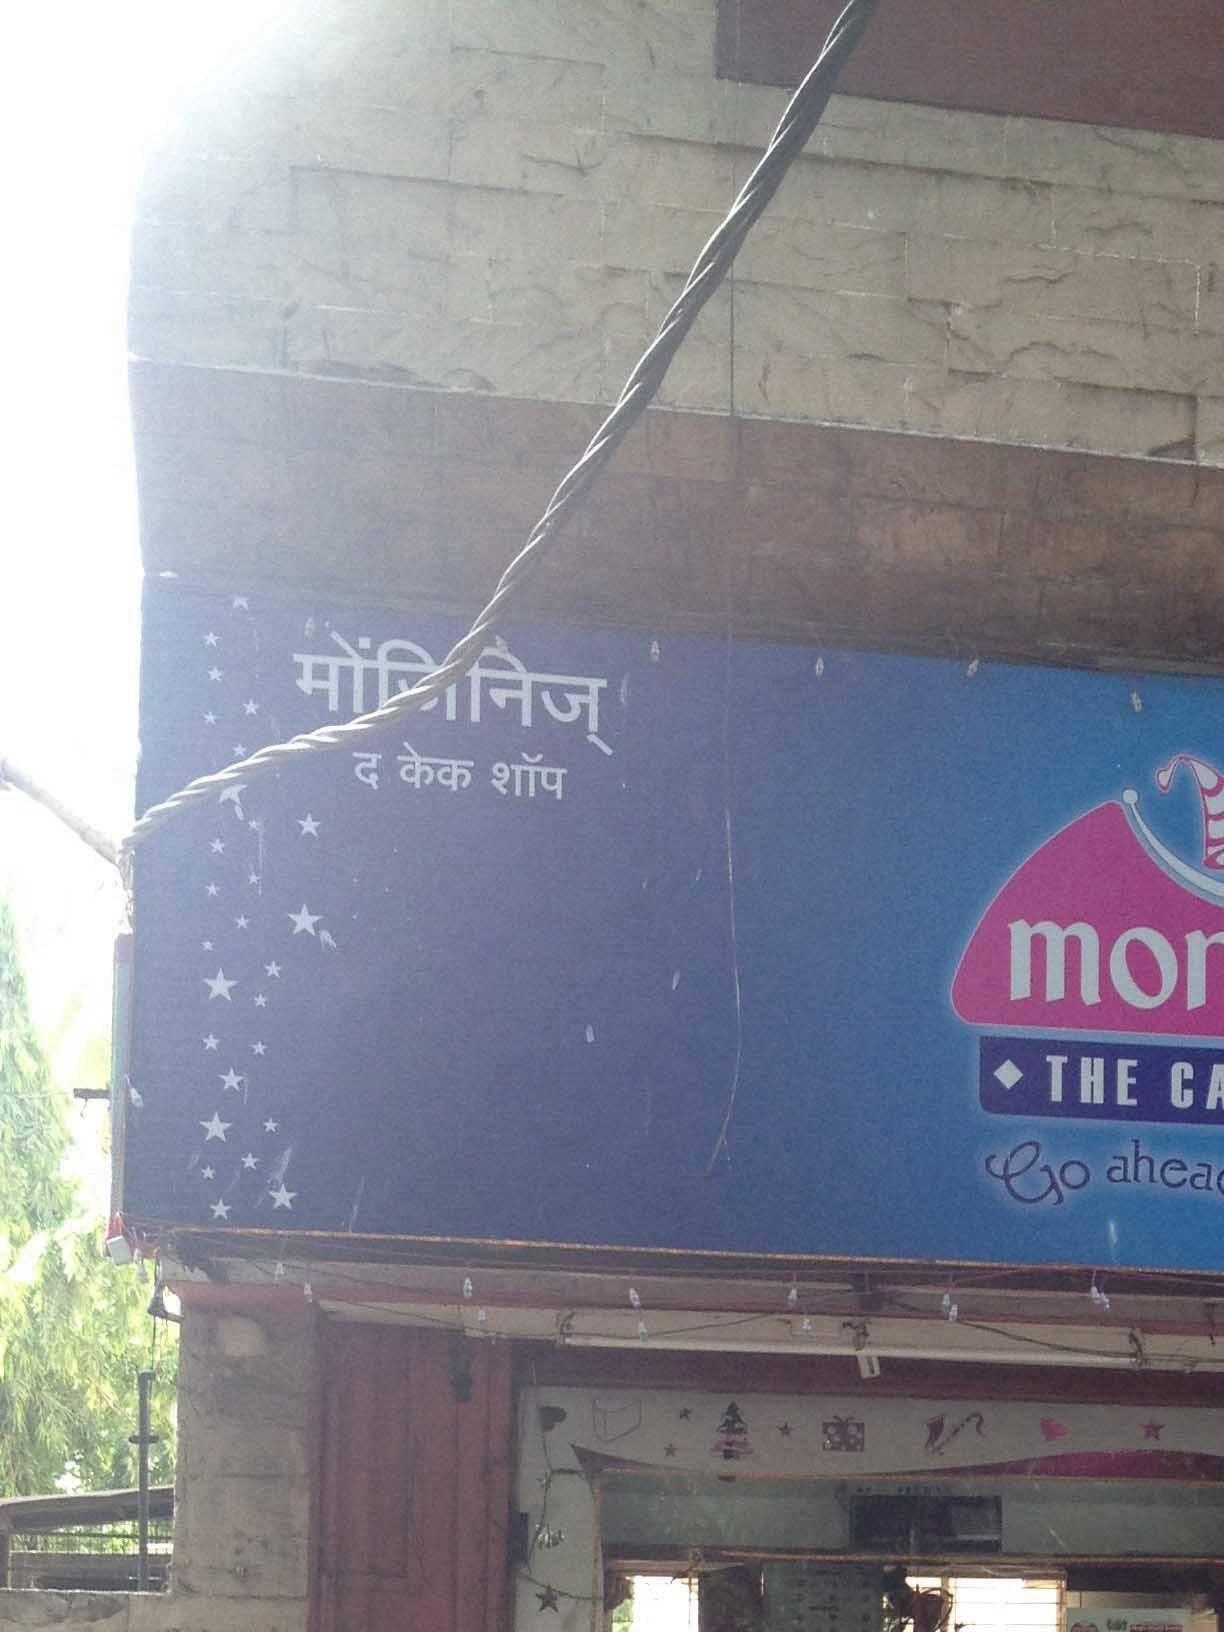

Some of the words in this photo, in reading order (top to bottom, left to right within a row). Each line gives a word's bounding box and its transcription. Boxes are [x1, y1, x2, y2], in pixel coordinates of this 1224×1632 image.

[352, 752, 382, 789] द
[397, 741, 474, 791] केक
[491, 752, 567, 799] शॉप
[1046, 1055, 1138, 1105] THE
[985, 1140, 1090, 1203] Go
